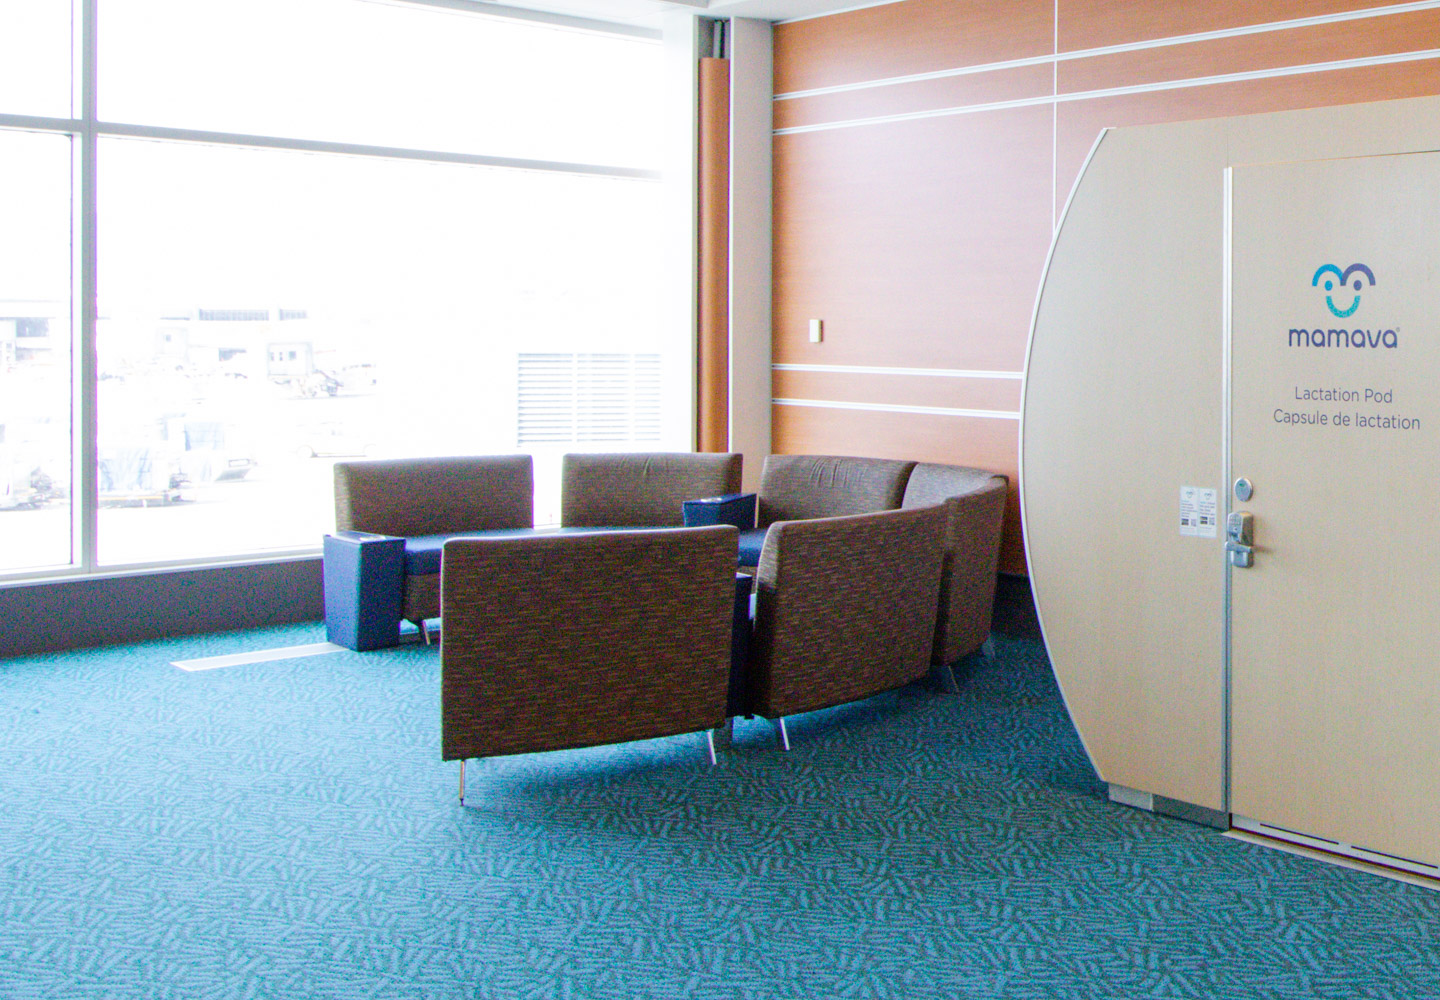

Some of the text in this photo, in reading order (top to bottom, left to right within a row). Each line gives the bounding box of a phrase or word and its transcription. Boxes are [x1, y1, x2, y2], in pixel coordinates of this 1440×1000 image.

[1288, 329, 1398, 348] mamava
[1295, 386, 1393, 404] Lactation Pod
[1273, 408, 1421, 430] Capsule de lactation
